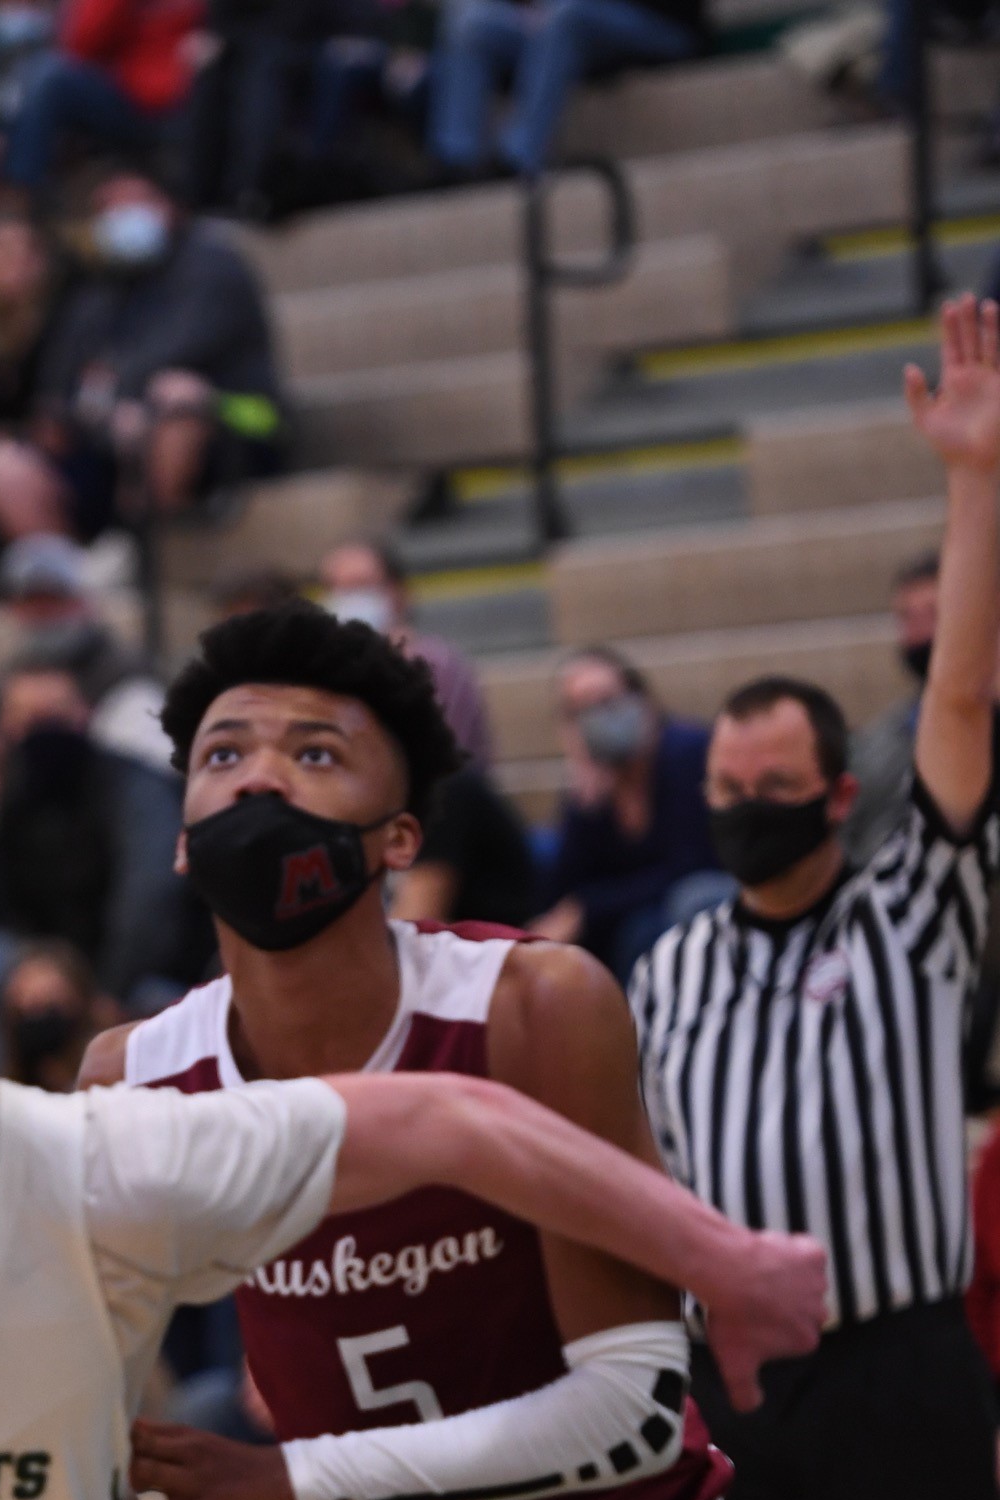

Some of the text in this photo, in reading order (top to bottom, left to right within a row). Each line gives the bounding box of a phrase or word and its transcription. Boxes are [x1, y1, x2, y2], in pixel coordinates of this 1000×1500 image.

[276, 844, 342, 914] M
[244, 1226, 503, 1296] uskegon
[336, 1325, 445, 1423] 5
